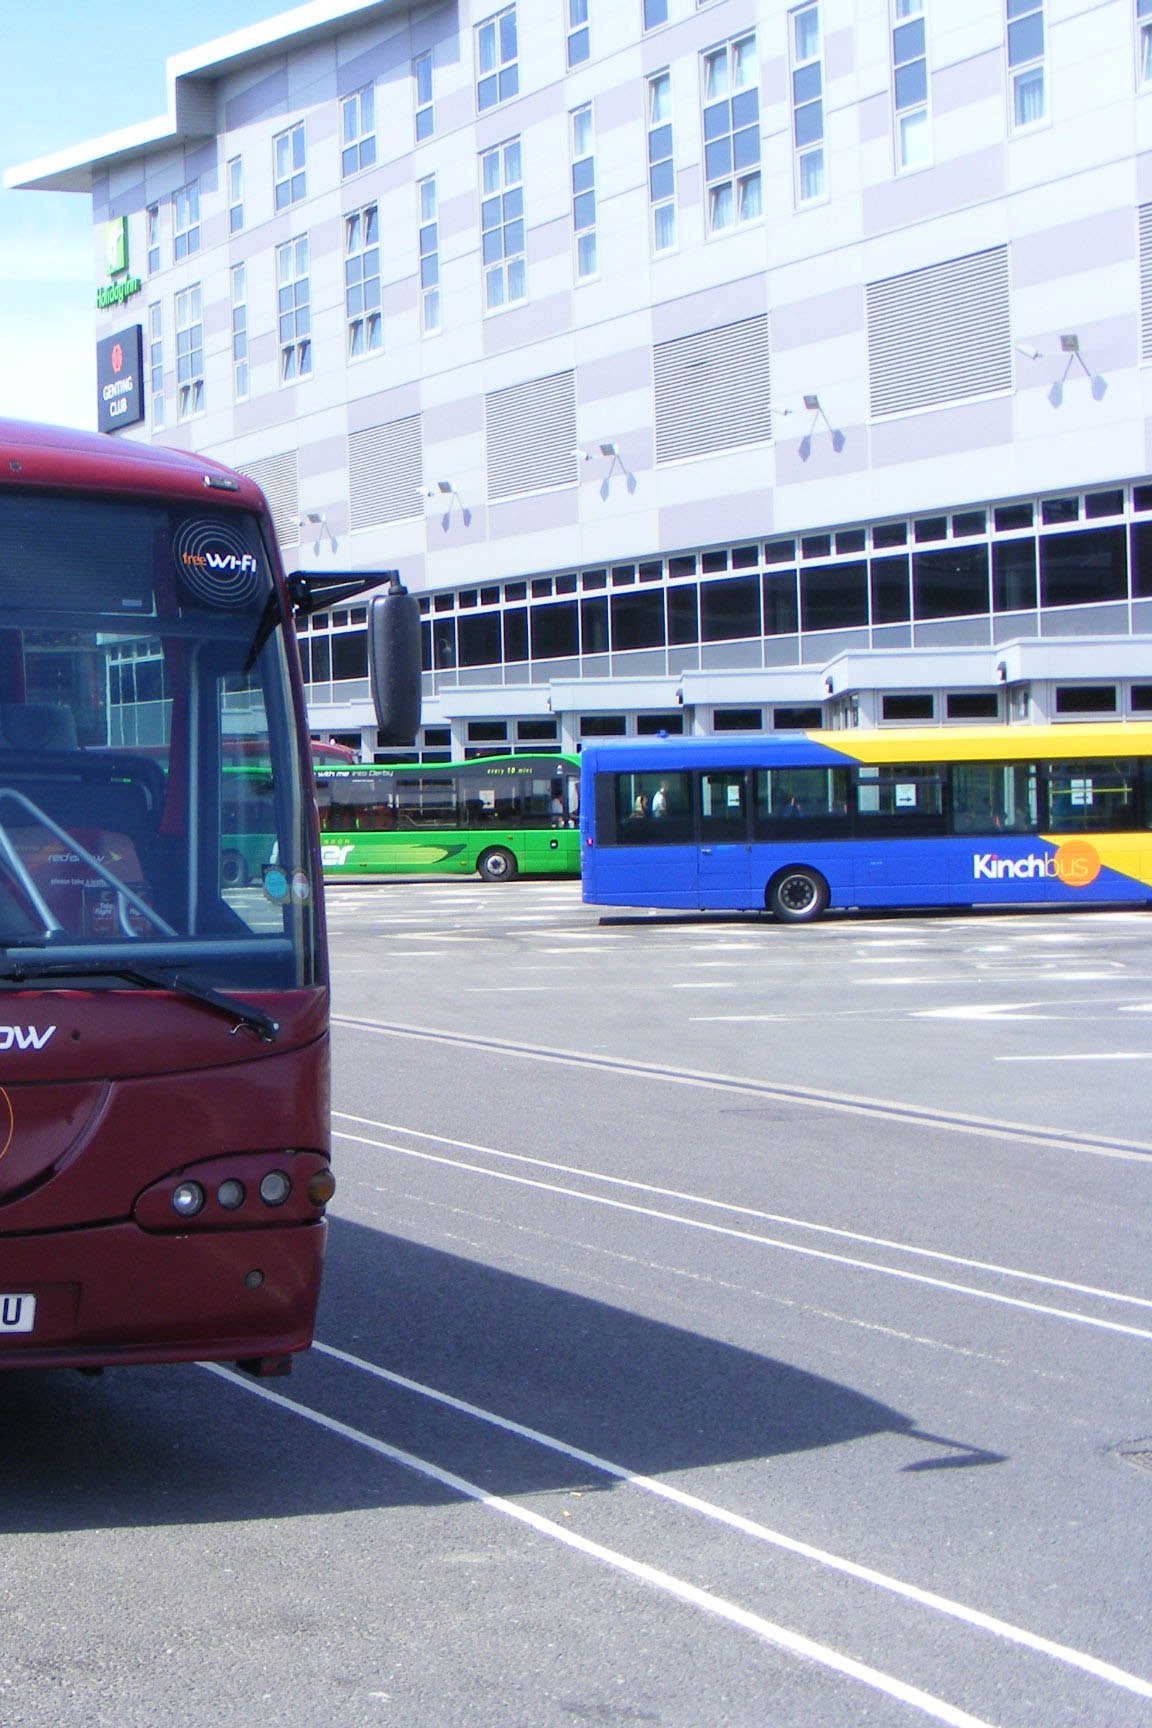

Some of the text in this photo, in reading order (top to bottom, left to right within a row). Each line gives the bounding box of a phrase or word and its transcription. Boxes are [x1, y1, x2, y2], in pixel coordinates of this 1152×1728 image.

[96, 274, 138, 308] Holiday Inn
[103, 376, 133, 401] GENTING
[110, 397, 127, 417] CLUB
[507, 767, 516, 775] 10
[974, 852, 1088, 879] Kinchbus
